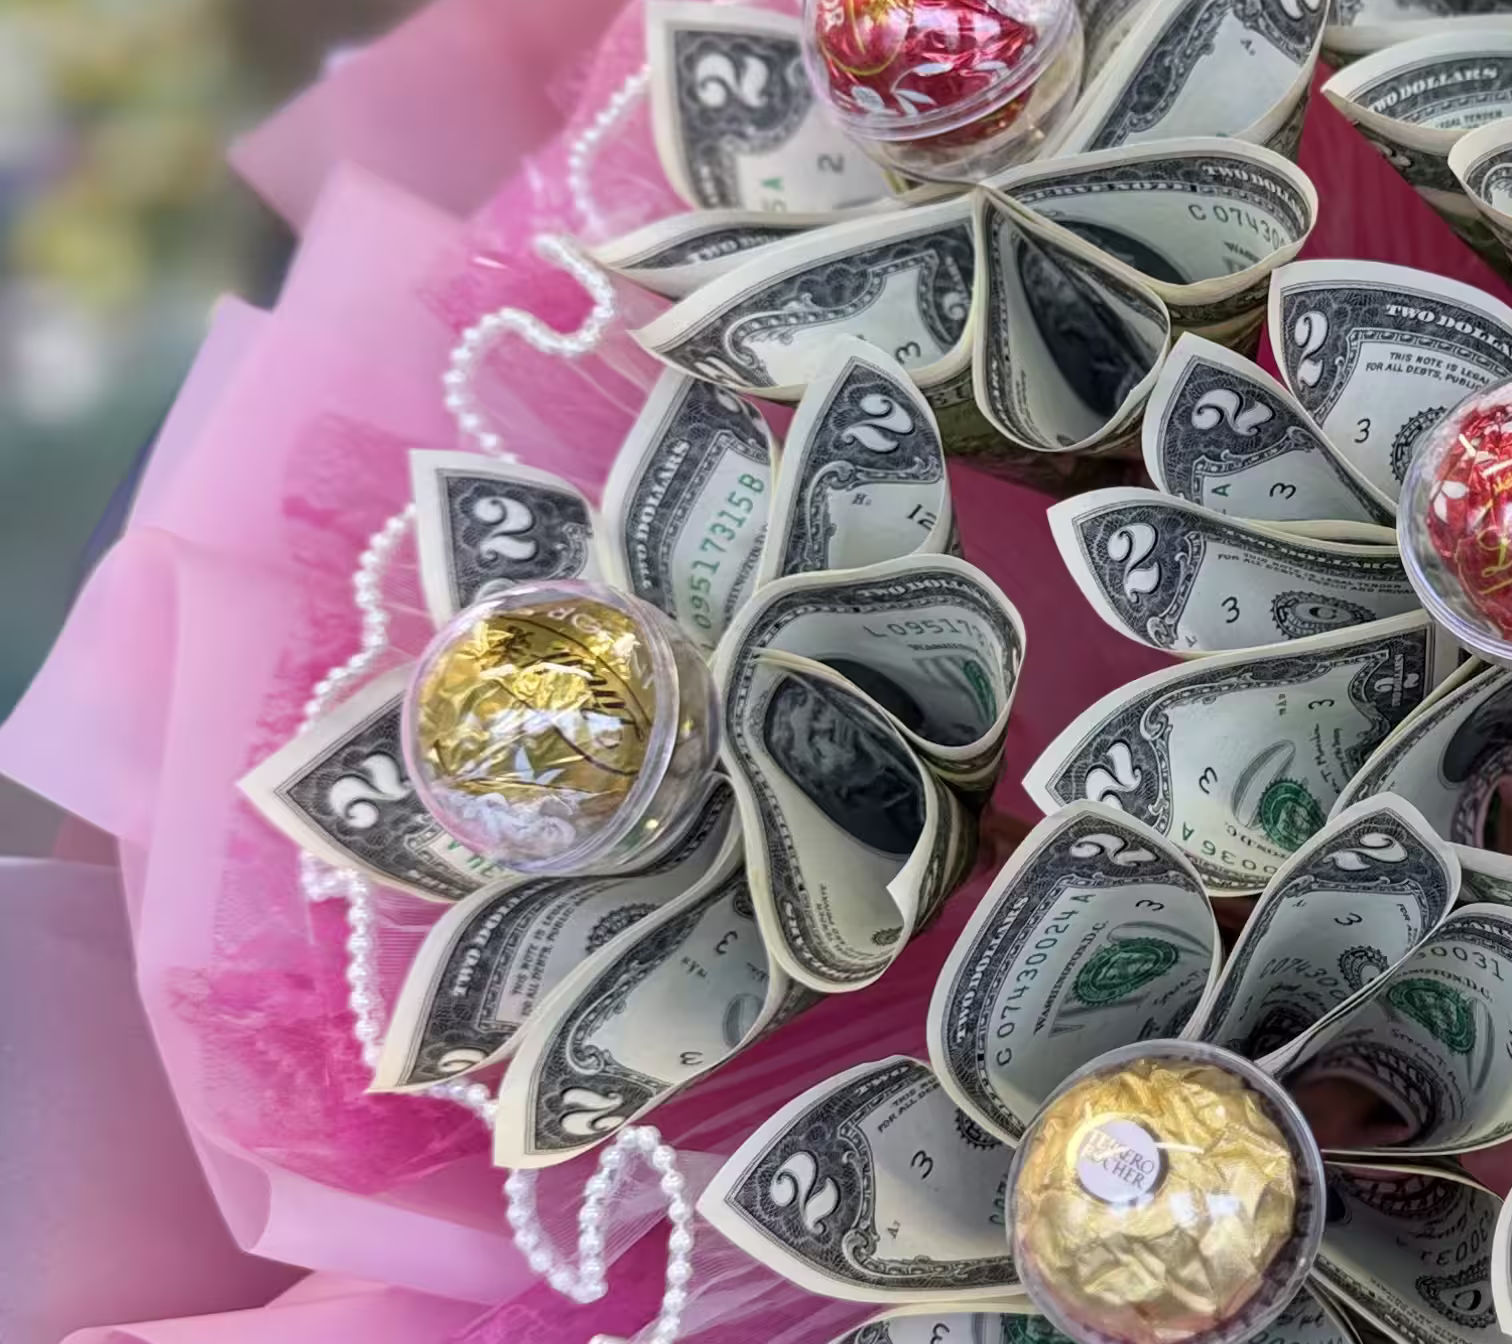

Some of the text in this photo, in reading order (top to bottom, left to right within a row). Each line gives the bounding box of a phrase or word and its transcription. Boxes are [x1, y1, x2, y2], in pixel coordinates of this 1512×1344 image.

[696, 52, 769, 108] 2
[1399, 67, 1498, 100] DOLLARS
[1385, 304, 1436, 324] TWO
[1293, 309, 1330, 389] 2
[1389, 351, 1413, 362] THIS
[1415, 355, 1443, 369] NOTE
[1446, 362, 1459, 372] IS
[1365, 361, 1384, 373] FOR
[1386, 363, 1404, 374] ALL
[840, 392, 914, 454] 2
[1191, 388, 1276, 437] 2
[1353, 417, 1372, 445] 3
[1211, 482, 1232, 497] A
[1269, 481, 1297, 500] 3
[471, 495, 537, 561] 2
[1106, 522, 1160, 604] 2
[1220, 596, 1241, 624] 3
[329, 753, 412, 829] 2
[1198, 765, 1219, 796] 3
[1070, 833, 1159, 868] 2
[1324, 830, 1410, 872] 2
[1135, 898, 1165, 912] 3
[1333, 911, 1364, 927] 3
[956, 896, 1030, 1045] TWO DOLLARS
[996, 893, 1098, 1068] C 07430024 A
[560, 1087, 627, 1136] 2
[909, 1148, 936, 1181] 3
[770, 1149, 842, 1236] 2
